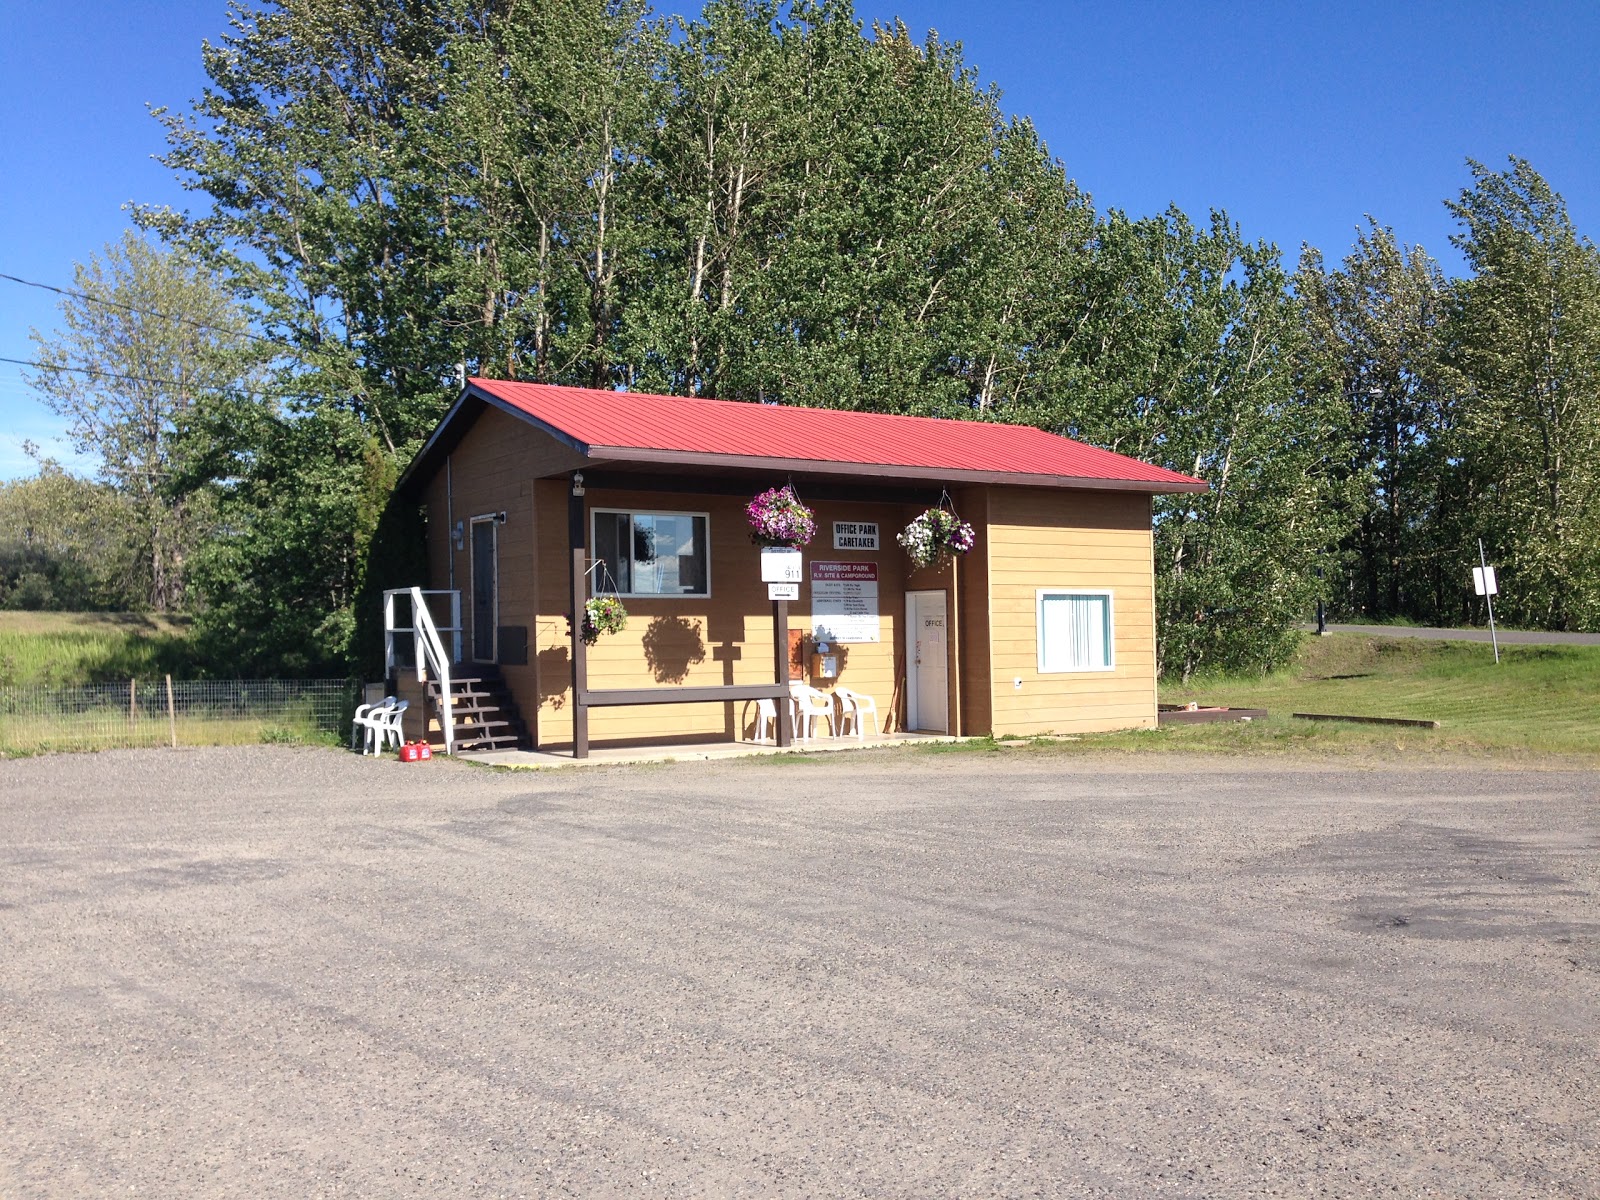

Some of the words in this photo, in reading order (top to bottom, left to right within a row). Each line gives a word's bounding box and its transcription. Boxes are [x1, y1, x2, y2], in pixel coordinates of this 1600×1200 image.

[836, 524, 856, 534] OFFICE
[858, 524, 876, 536] PARK
[838, 537, 874, 548] CARETAKER
[819, 564, 851, 572] RIVERSIDE
[784, 569, 800, 579] 911
[771, 585, 795, 593] OFFICE
